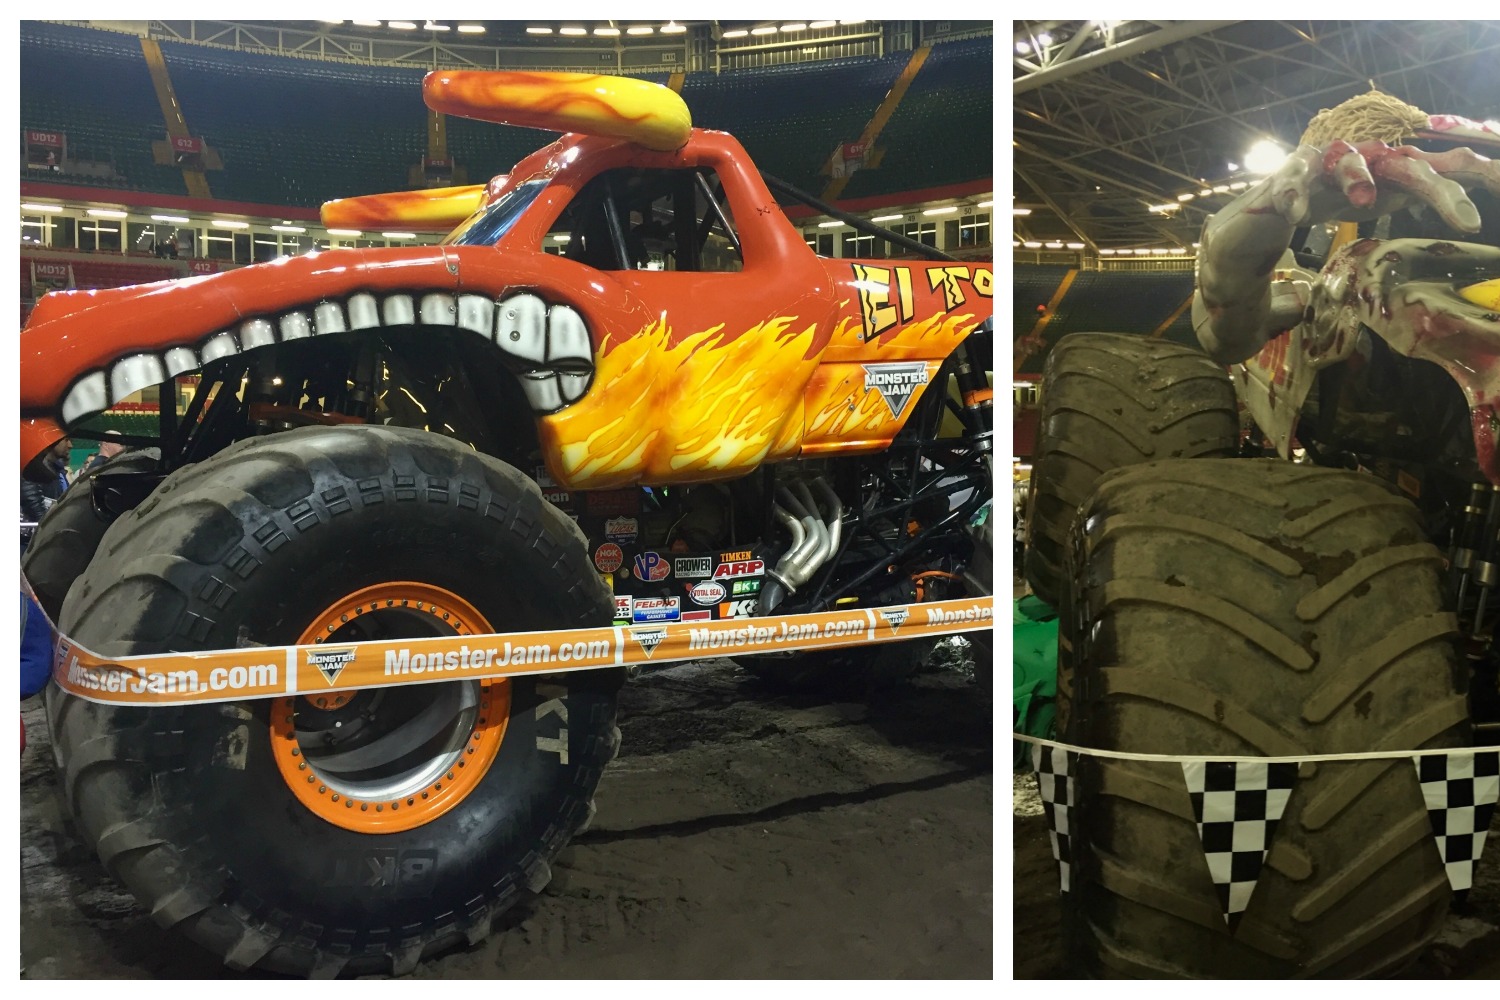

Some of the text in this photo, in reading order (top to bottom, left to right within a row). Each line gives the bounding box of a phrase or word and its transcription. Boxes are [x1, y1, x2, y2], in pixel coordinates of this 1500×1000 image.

[32, 132, 57, 142] UD12
[177, 138, 193, 147] 612
[36, 264, 66, 275] MD12
[193, 263, 211, 272] 412
[864, 371, 928, 387] MONSTER
[883, 384, 911, 396] JAM
[600, 549, 618, 557] NGK
[720, 551, 752, 562] TIMKEN
[676, 558, 711, 572] CROWER
[715, 561, 763, 577] ARP
[693, 588, 722, 597] TOTAL SEAL
[733, 581, 759, 593] BKT
[631, 632, 667, 641] MONSTER
[688, 619, 865, 650] MonsterJam.com
[306, 653, 356, 665] MONSTER
[384, 638, 610, 676] MonsterJam.com
[320, 662, 344, 670] JAM
[67, 655, 279, 694] MonsterJam.com
